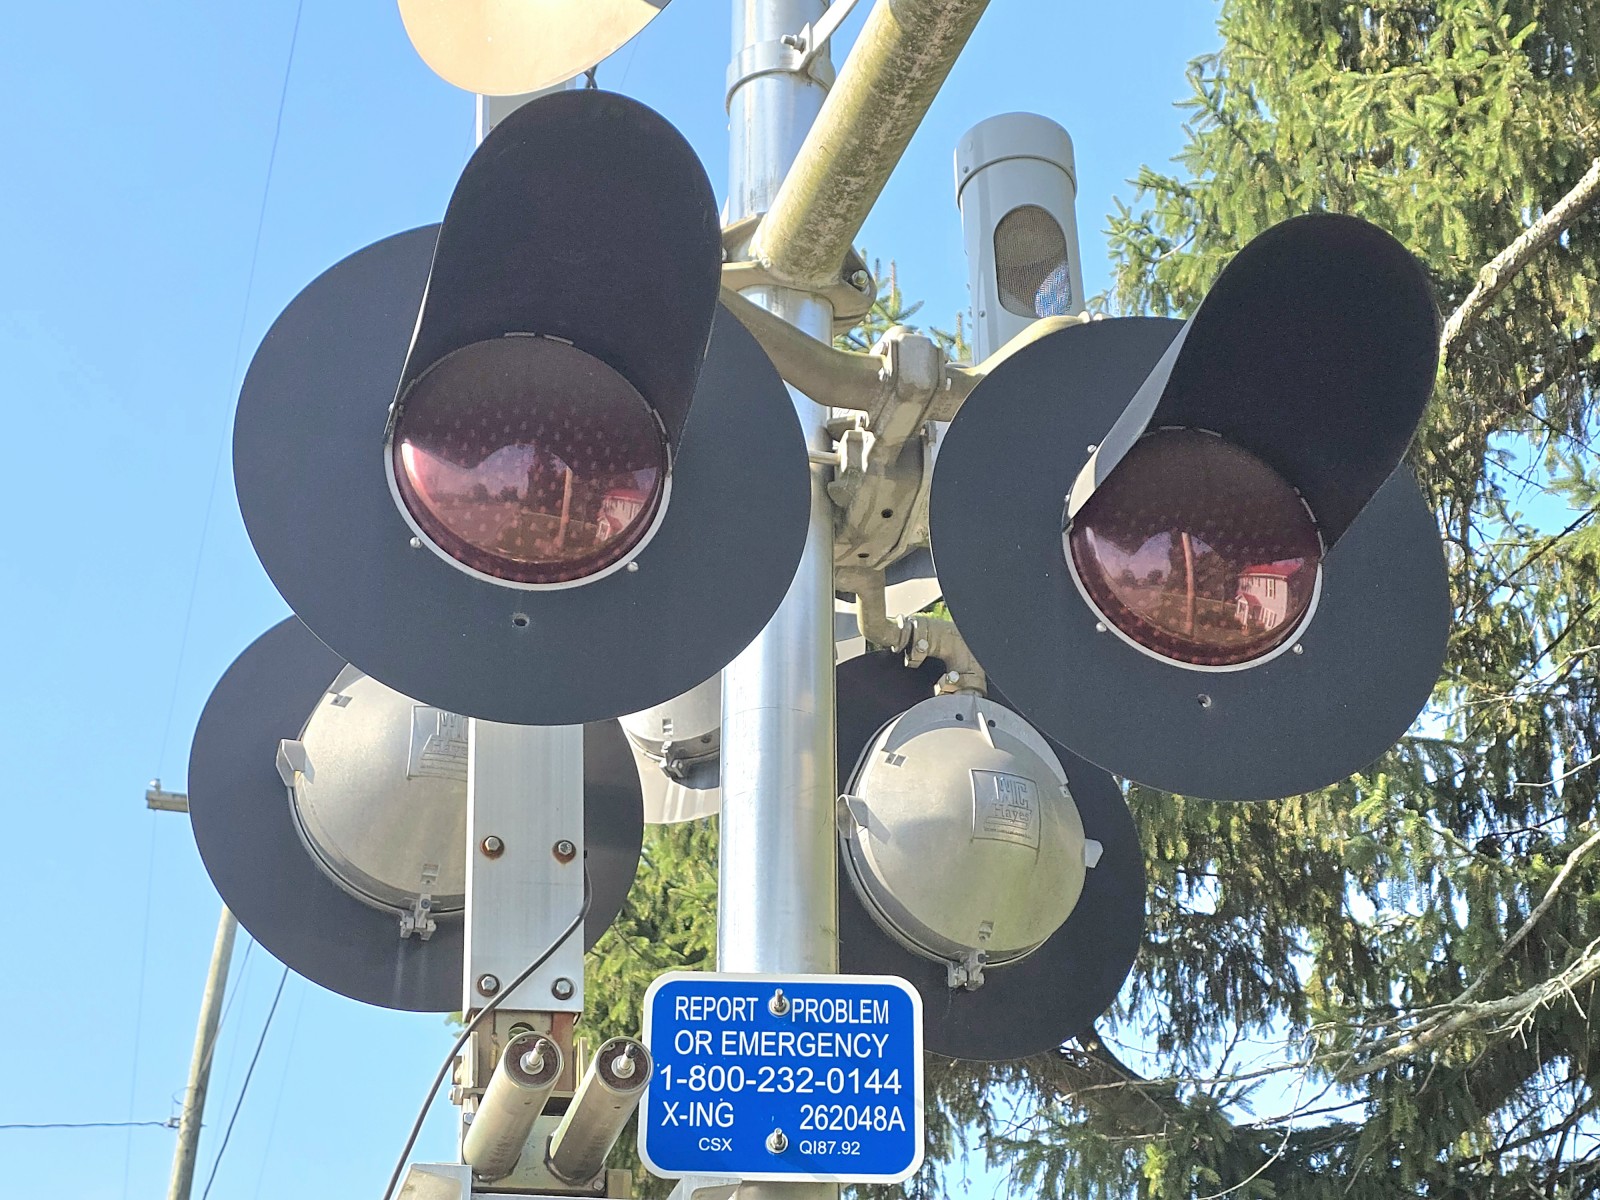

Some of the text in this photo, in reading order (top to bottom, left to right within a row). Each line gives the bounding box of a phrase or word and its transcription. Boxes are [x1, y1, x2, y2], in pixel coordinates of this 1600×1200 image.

[675, 996, 889, 1025] REPORT PROBLEM
[674, 1029, 889, 1059] OR EMERGENCY
[660, 1064, 902, 1095] 1-800-232-0144
[661, 1101, 906, 1132] X-ING 262048A
[698, 1137, 861, 1156] CSX QI87.92
